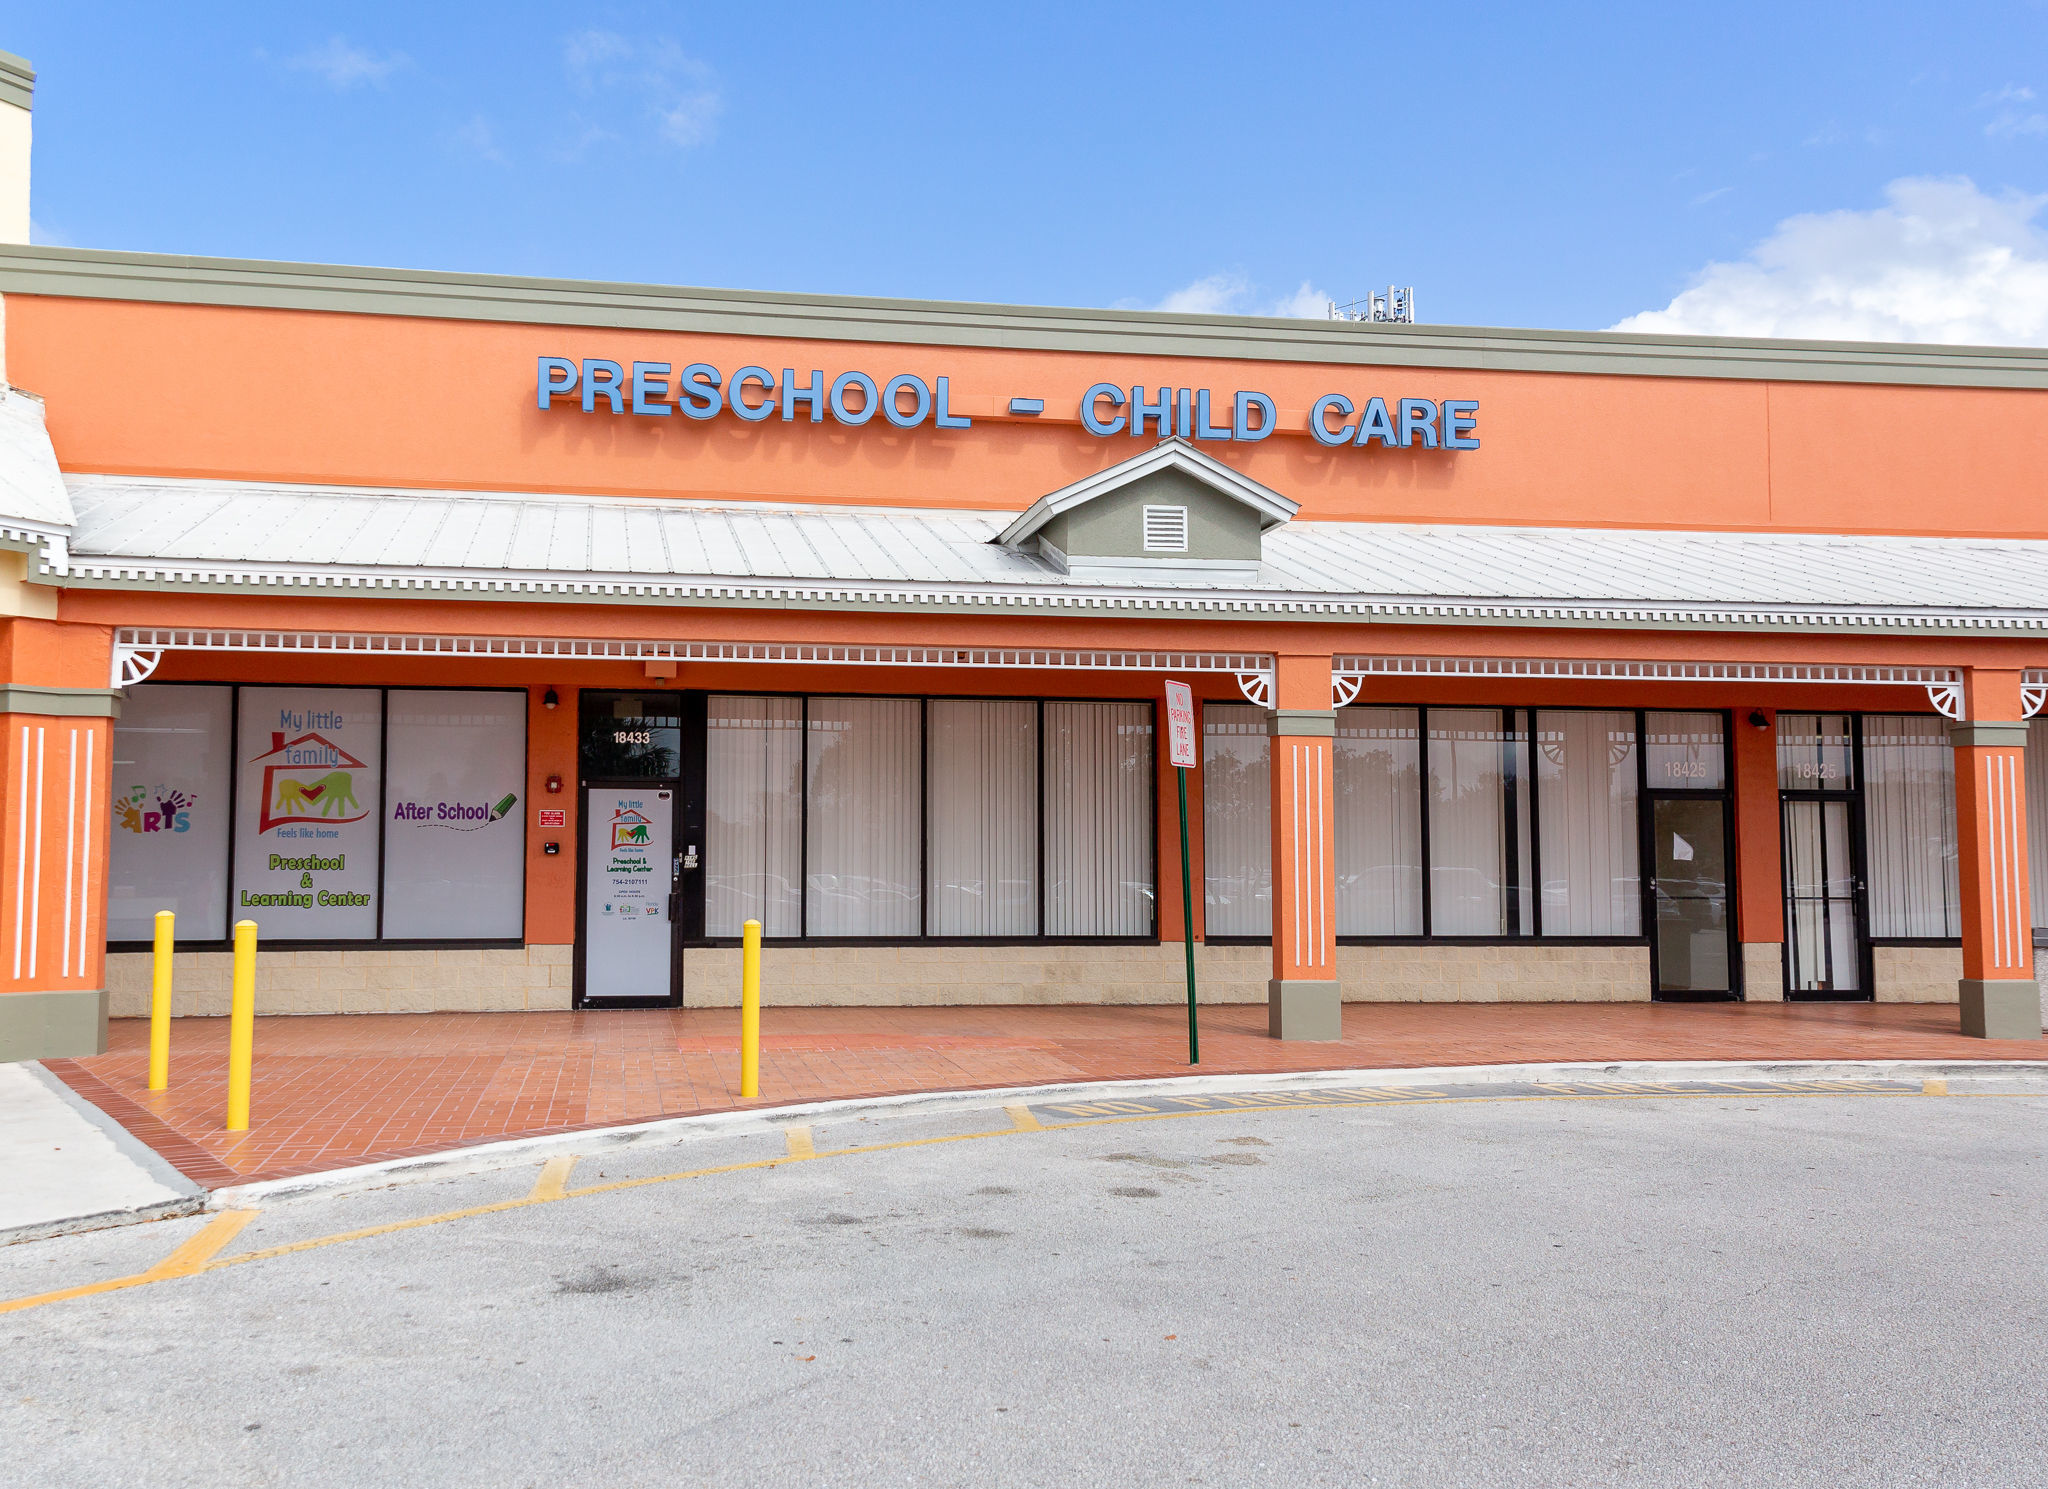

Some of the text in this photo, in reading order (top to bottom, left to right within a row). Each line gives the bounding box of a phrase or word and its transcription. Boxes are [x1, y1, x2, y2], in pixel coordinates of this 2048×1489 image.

[537, 356, 1480, 450] PRESCHOOL - CHILD CARE
[1176, 693, 1184, 706] NO
[280, 709, 343, 732] My little
[1170, 708, 1191, 724] PARKING
[614, 731, 650, 745] 18433
[1176, 726, 1188, 740] FIRE
[285, 744, 339, 768] family
[1176, 743, 1190, 757] LANE
[1664, 761, 1706, 778] 18425
[1795, 762, 1837, 779] 18425
[394, 802, 489, 821] After School
[618, 800, 643, 810] My little
[119, 805, 191, 833] ARTS
[620, 814, 642, 823] family
[277, 828, 339, 839] Feels like home
[269, 853, 344, 871] Preschool
[613, 857, 642, 865] Preschool
[607, 865, 653, 874] Learning Center
[300, 873, 314, 889] &
[241, 891, 371, 909] Learning Center
